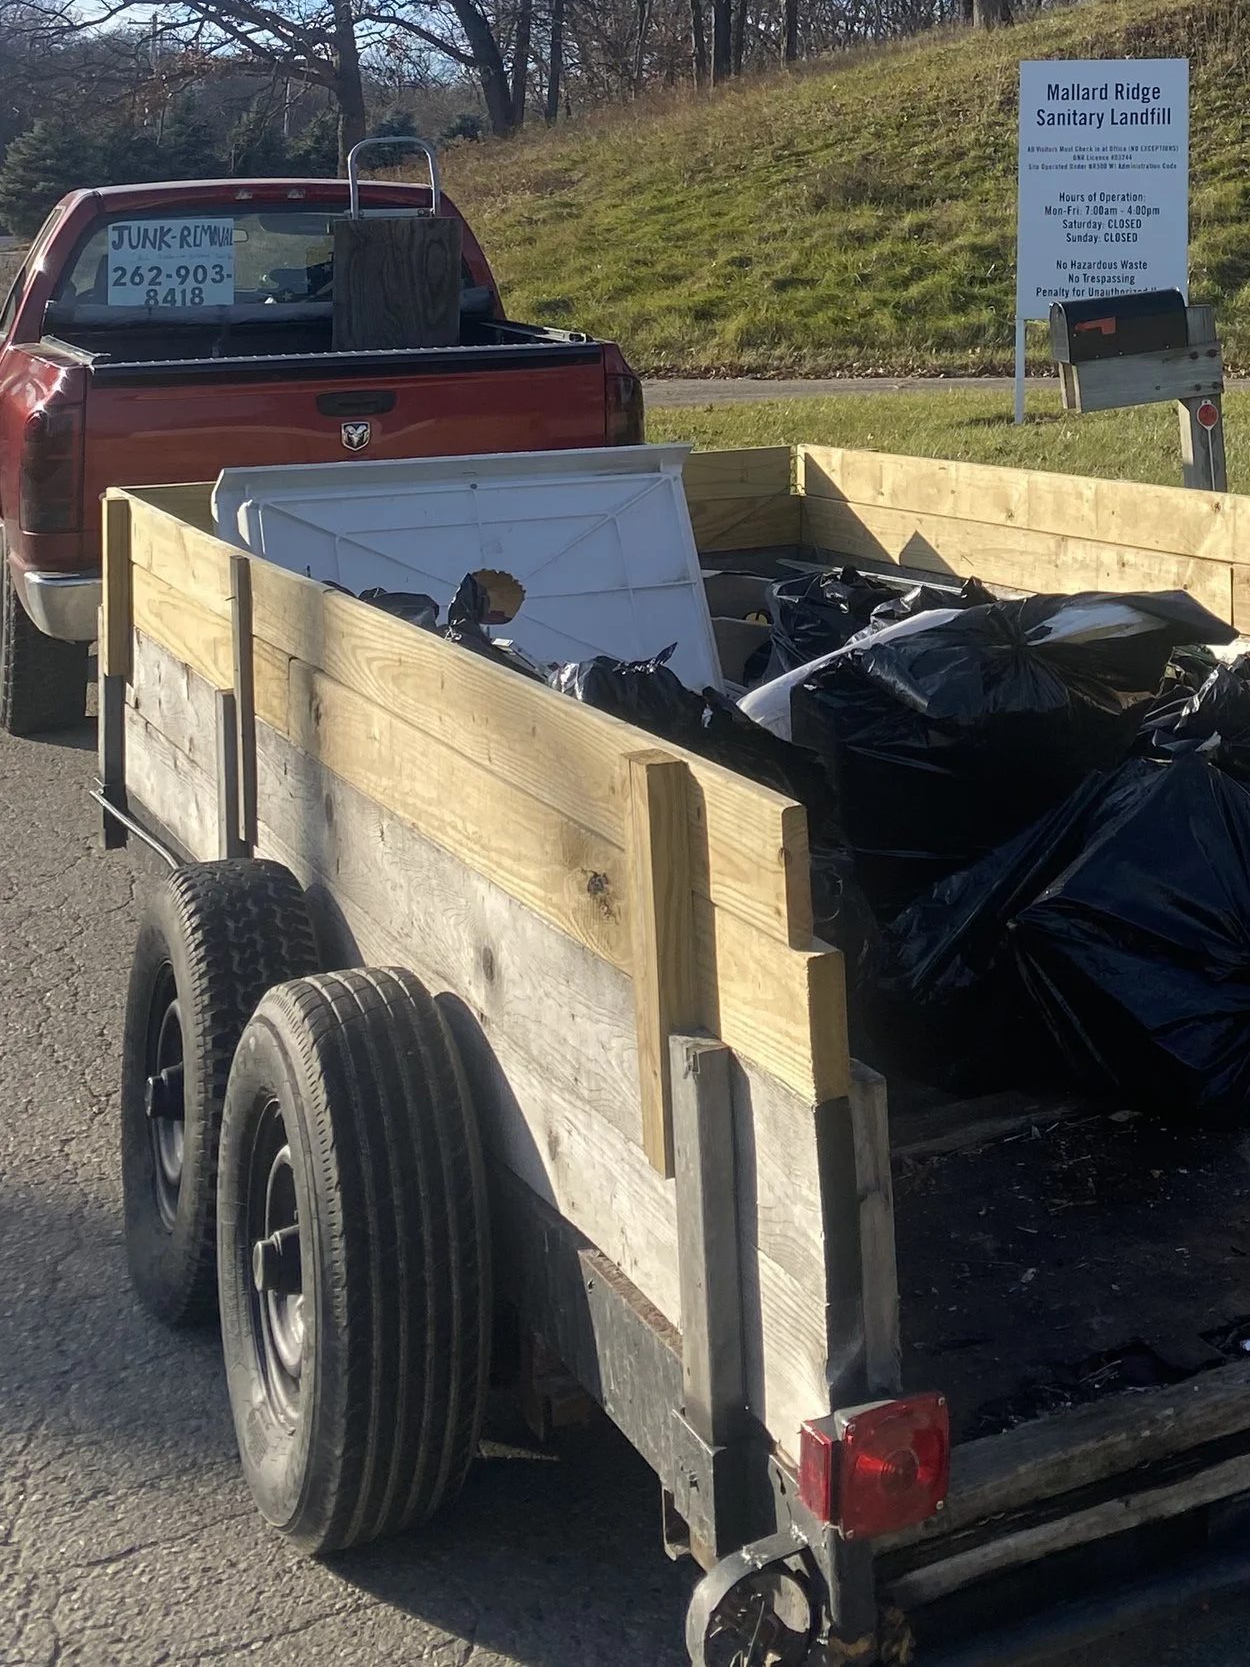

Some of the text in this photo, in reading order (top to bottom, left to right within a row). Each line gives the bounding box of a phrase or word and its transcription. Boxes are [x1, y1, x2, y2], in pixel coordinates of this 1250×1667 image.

[1047, 82, 1161, 104] Mallard Ridge
[1036, 107, 1171, 129] Sanitary Landfill
[1041, 163, 1068, 171] Operated
[1059, 191, 1146, 204] Hours of Operation:
[1044, 205, 1082, 216] Mon-Fri:
[1085, 205, 1118, 215] 7:00am
[1127, 205, 1160, 217] 4:00pm
[1062, 219, 1142, 231] Saturday: CLOSED
[1066, 232, 1138, 244] Sunday: CLOSED
[1056, 259, 1148, 270] No Hazardous Waste
[112, 263, 232, 287] 262-903-
[1068, 273, 1136, 285] No Trespassing
[144, 286, 205, 307] 8418
[1036, 286, 1070, 298] Penalty
[1072, 286, 1085, 297] for
